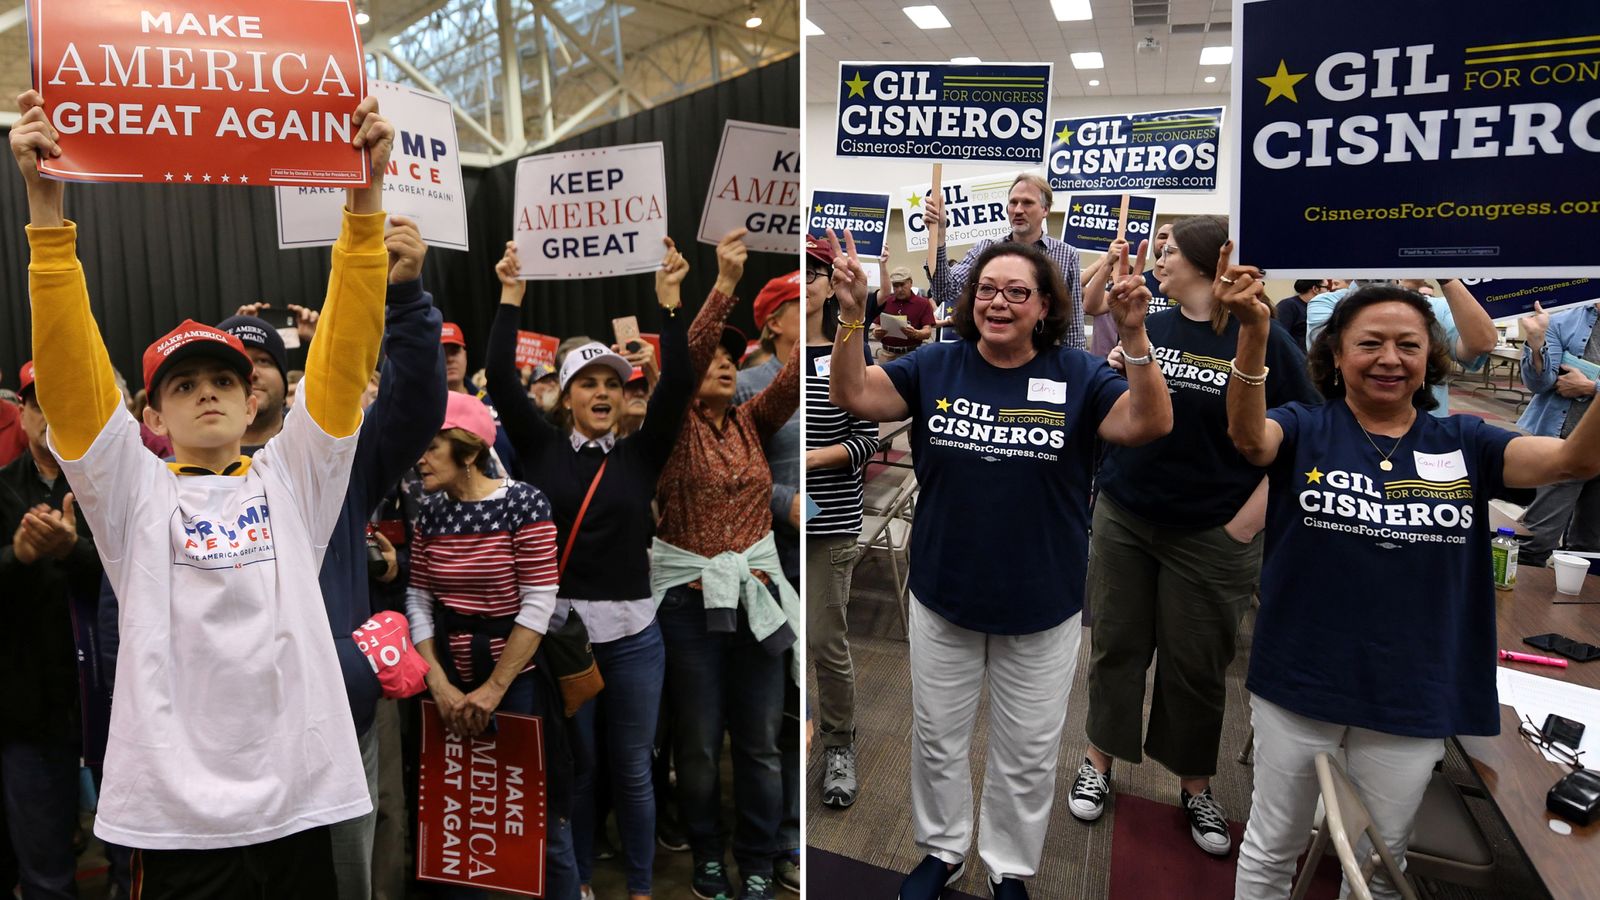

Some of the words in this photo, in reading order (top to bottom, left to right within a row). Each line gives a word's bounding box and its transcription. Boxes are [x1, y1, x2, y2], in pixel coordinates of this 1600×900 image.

[141, 10, 263, 39] MAKE
[48, 42, 355, 97] AMERICA
[1314, 43, 1449, 102] GIL
[1463, 67, 1521, 92] FOR
[1530, 61, 1600, 85] CON
[873, 70, 936, 101] GIL
[943, 89, 969, 101] FOR
[971, 90, 1044, 103] CONGRESS
[52, 101, 200, 136] GREAT
[215, 107, 351, 144] AGAIN
[841, 105, 1043, 140] CISNEROS
[1077, 120, 1127, 146] GIL
[1252, 97, 1600, 170] CISNERO
[1132, 133, 1152, 144] FOR
[1155, 128, 1216, 142] CONGRESS
[841, 139, 1041, 159] CisnerosForCongress.com
[1050, 142, 1215, 175] CISNEROS
[385, 160, 441, 184] NCE
[550, 168, 624, 195] KEEP
[1050, 175, 1214, 189] CisnerosForCongress.com
[299, 187, 335, 195] MAKE
[399, 184, 425, 196] GREAT
[428, 190, 454, 202] AGAIN!
[716, 174, 800, 206] AME
[925, 185, 968, 206] IL
[517, 194, 663, 231] AMERICA
[824, 204, 847, 216] GIL
[908, 202, 1008, 232] CNER
[1083, 203, 1109, 216] GIL
[745, 212, 800, 235] GRE
[811, 217, 883, 233] CISNEROS
[911, 226, 1012, 246] CisosForCongres
[1069, 215, 1150, 234] CISNEOS
[542, 231, 639, 259] GREAT
[1485, 277, 1589, 303] CisnerosForCongress.com
[156, 333, 183, 353] MAKE
[183, 330, 228, 344] AMERICA
[236, 325, 268, 338] AMERICA
[242, 333, 265, 344] AGAIN
[163, 339, 193, 356] GRE
[1155, 346, 1180, 363] GIL
[1156, 359, 1228, 386] NEROS
[1194, 360, 1231, 373] CONGRESS
[952, 398, 994, 421] GIL
[1017, 416, 1065, 427] CONGRESS
[928, 414, 1065, 449] CISNEROS
[930, 436, 1058, 461] CisnerosForCongress.com
[1326, 470, 1381, 498] GIL
[1385, 490, 1409, 500] FOR
[1412, 488, 1473, 500] CONGRESS
[1299, 489, 1473, 529] CISNEROS
[1303, 516, 1466, 544] CisnerosForCongress.com
[202, 552, 237, 560] AMERICA
[240, 547, 257, 556] GREAT
[444, 730, 464, 790] REAT
[468, 737, 497, 880] MERICA
[504, 765, 524, 836] MAKE
[442, 795, 462, 875] AGAIN
